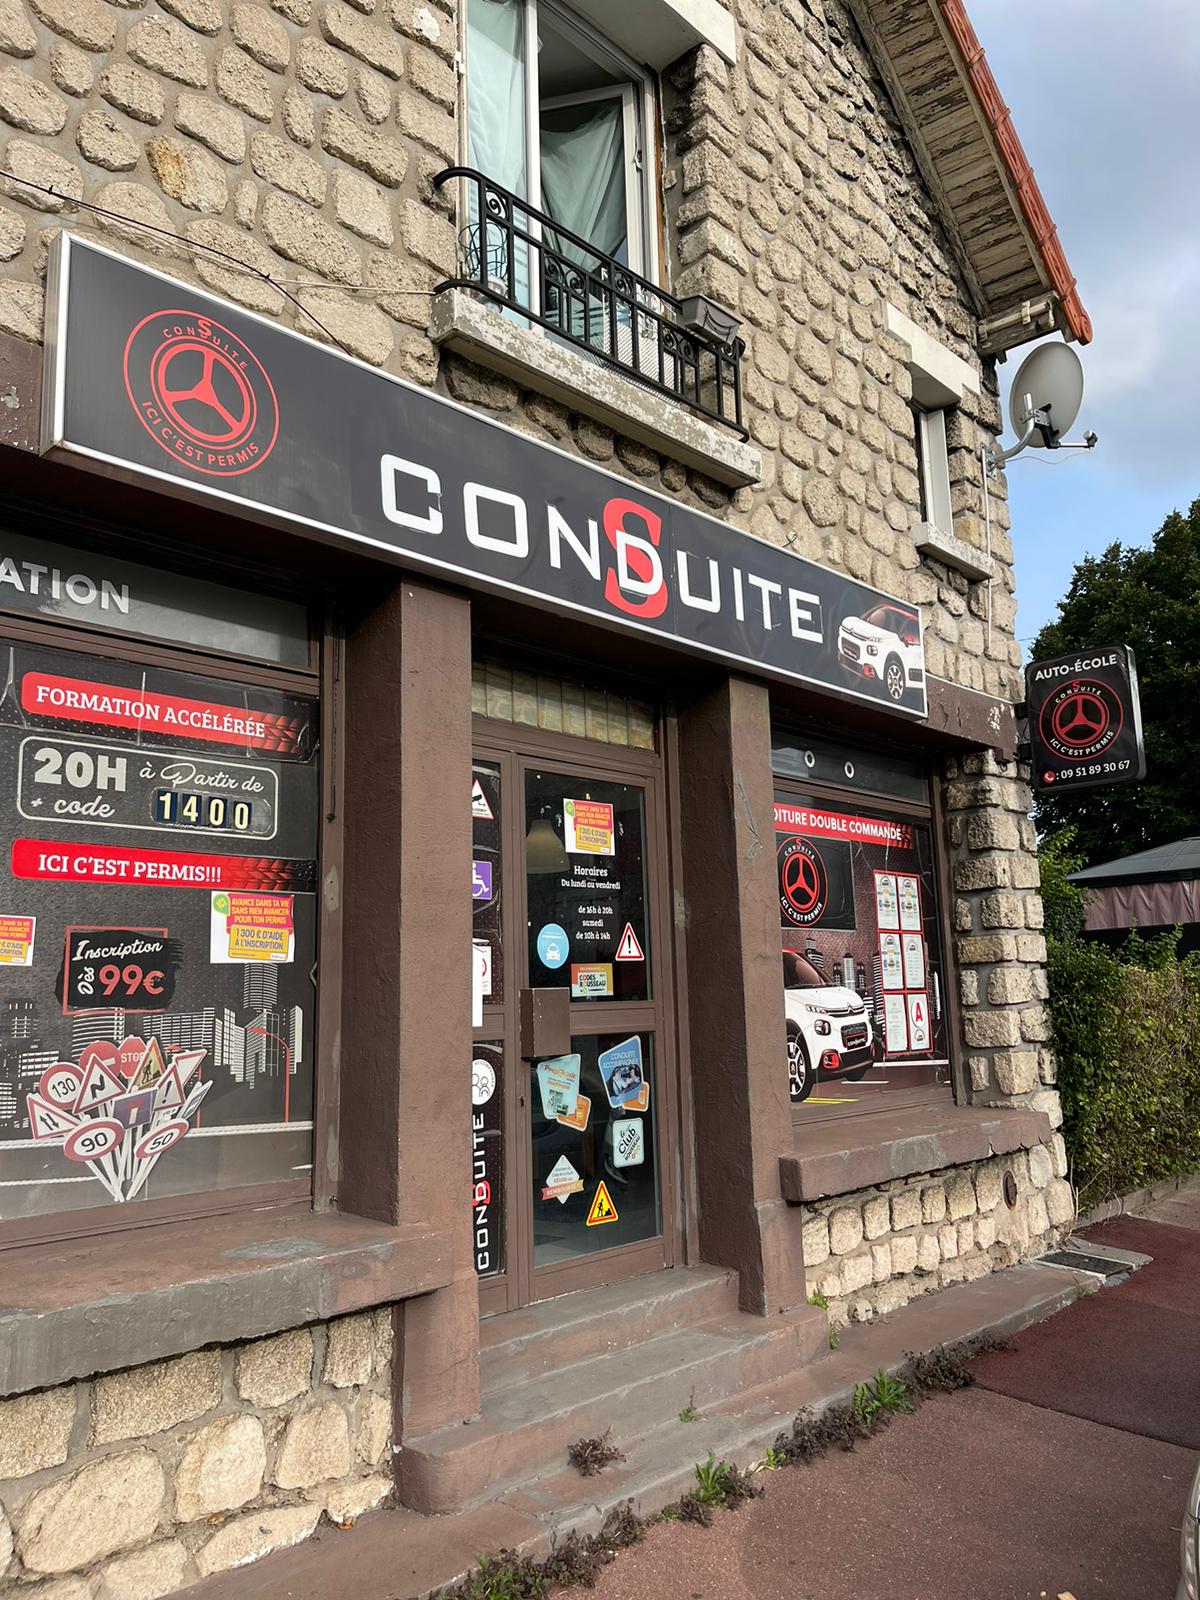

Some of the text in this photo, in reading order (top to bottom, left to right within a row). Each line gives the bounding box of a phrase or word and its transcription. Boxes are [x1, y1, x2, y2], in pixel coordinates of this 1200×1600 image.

[142, 401, 260, 466] ICI C'EST PERMIS
[0, 557, 129, 614] ATION
[1034, 654, 1117, 682] AUTO-ÉCOLE
[36, 685, 266, 738] FORMATION ACCÉLÉRÉE
[1050, 730, 1115, 757] ICI C'EST PERMIS
[34, 747, 264, 793] 20H à Partir de
[1061, 769, 1073, 780] 09
[1075, 766, 1087, 777] 51
[1089, 764, 1101, 775] 89
[1103, 762, 1116, 772] 30
[1118, 760, 1130, 770] 67
[54, 795, 116, 818] code
[810, 814, 848, 833] DOUBLE
[849, 821, 902, 841] COMMANDE
[38, 854, 222, 883] ICI C'EST PERMIS!!!
[574, 865, 608, 877] Horaires
[561, 879, 570, 887] Du
[570, 879, 586, 888] lundi
[595, 881, 621, 890] vendredi
[231, 898, 290, 908] AVANCE DANS TA VIE
[231, 907, 290, 916] SANS RIEN AVANCER
[578, 905, 586, 914] de
[597, 905, 602, 914] à
[602, 906, 614, 915] 20h
[780, 896, 823, 921] ICI C'EST PERMIS
[234, 915, 287, 924] POUR TON PERMIS
[582, 919, 604, 927] samedi
[240, 939, 283, 950] L'INSCRIPTION
[256, 930, 262, 938] €
[262, 930, 284, 940] D'AIDE
[576, 931, 584, 940] de
[584, 931, 594, 940] 10h
[595, 931, 600, 940] à
[72, 939, 163, 961] Inscription
[99, 964, 165, 995] 99€
[915, 1001, 924, 1022] A
[51, 1077, 76, 1099] 130
[81, 1132, 108, 1153] 90
[150, 1132, 174, 1151] 50
[618, 1127, 636, 1154] Club
